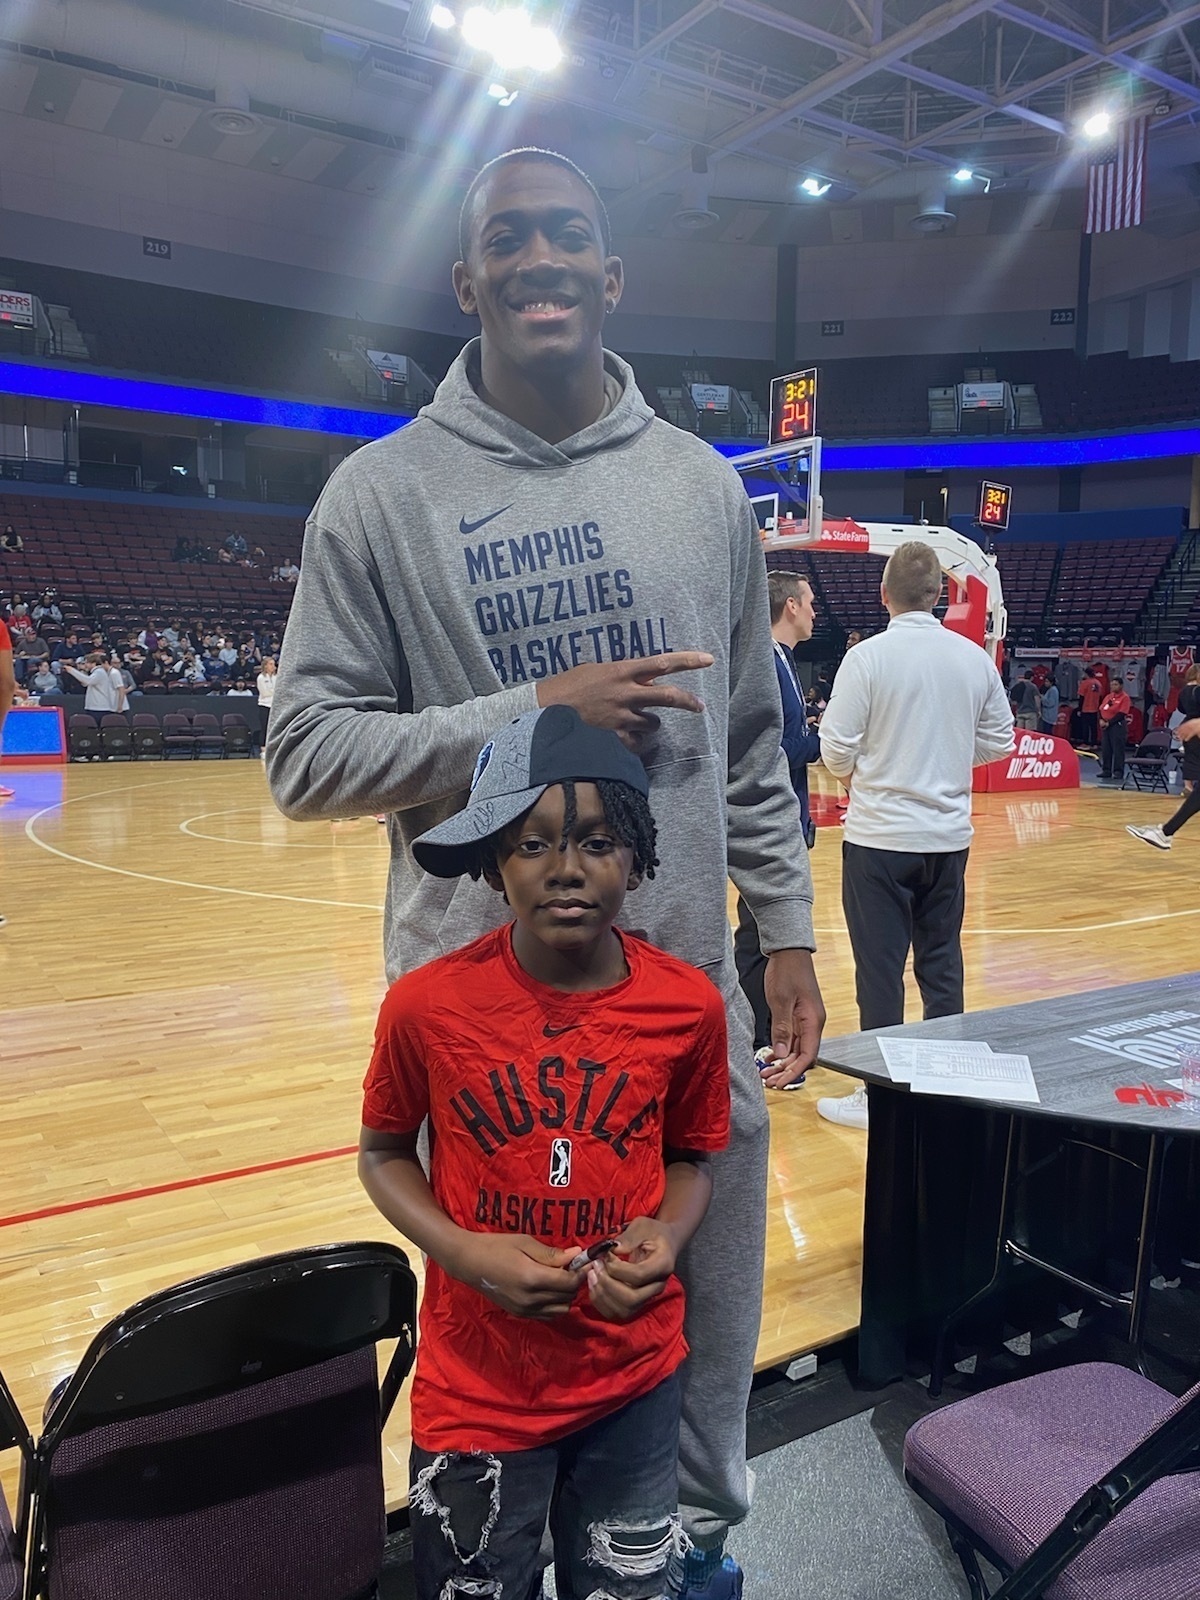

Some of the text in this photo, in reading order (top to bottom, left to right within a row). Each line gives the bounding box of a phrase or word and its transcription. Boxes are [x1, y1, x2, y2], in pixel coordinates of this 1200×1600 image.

[146, 241, 169, 255] 219
[0, 293, 30, 307] DERS
[1053, 311, 1073, 322] 222
[824, 324, 841, 333] 221
[786, 379, 814, 402] 3:21
[781, 401, 809, 437] 24
[985, 502, 1001, 520] 24
[464, 521, 604, 585] MEMPHIS
[474, 568, 634, 636] GRIZZLIES
[487, 617, 673, 685] BASKETBALL
[1018, 735, 1054, 755] Auto
[1020, 757, 1061, 778] Zone
[449, 1056, 659, 1160] HUSTLE
[475, 1188, 630, 1238] BASKETBALL
